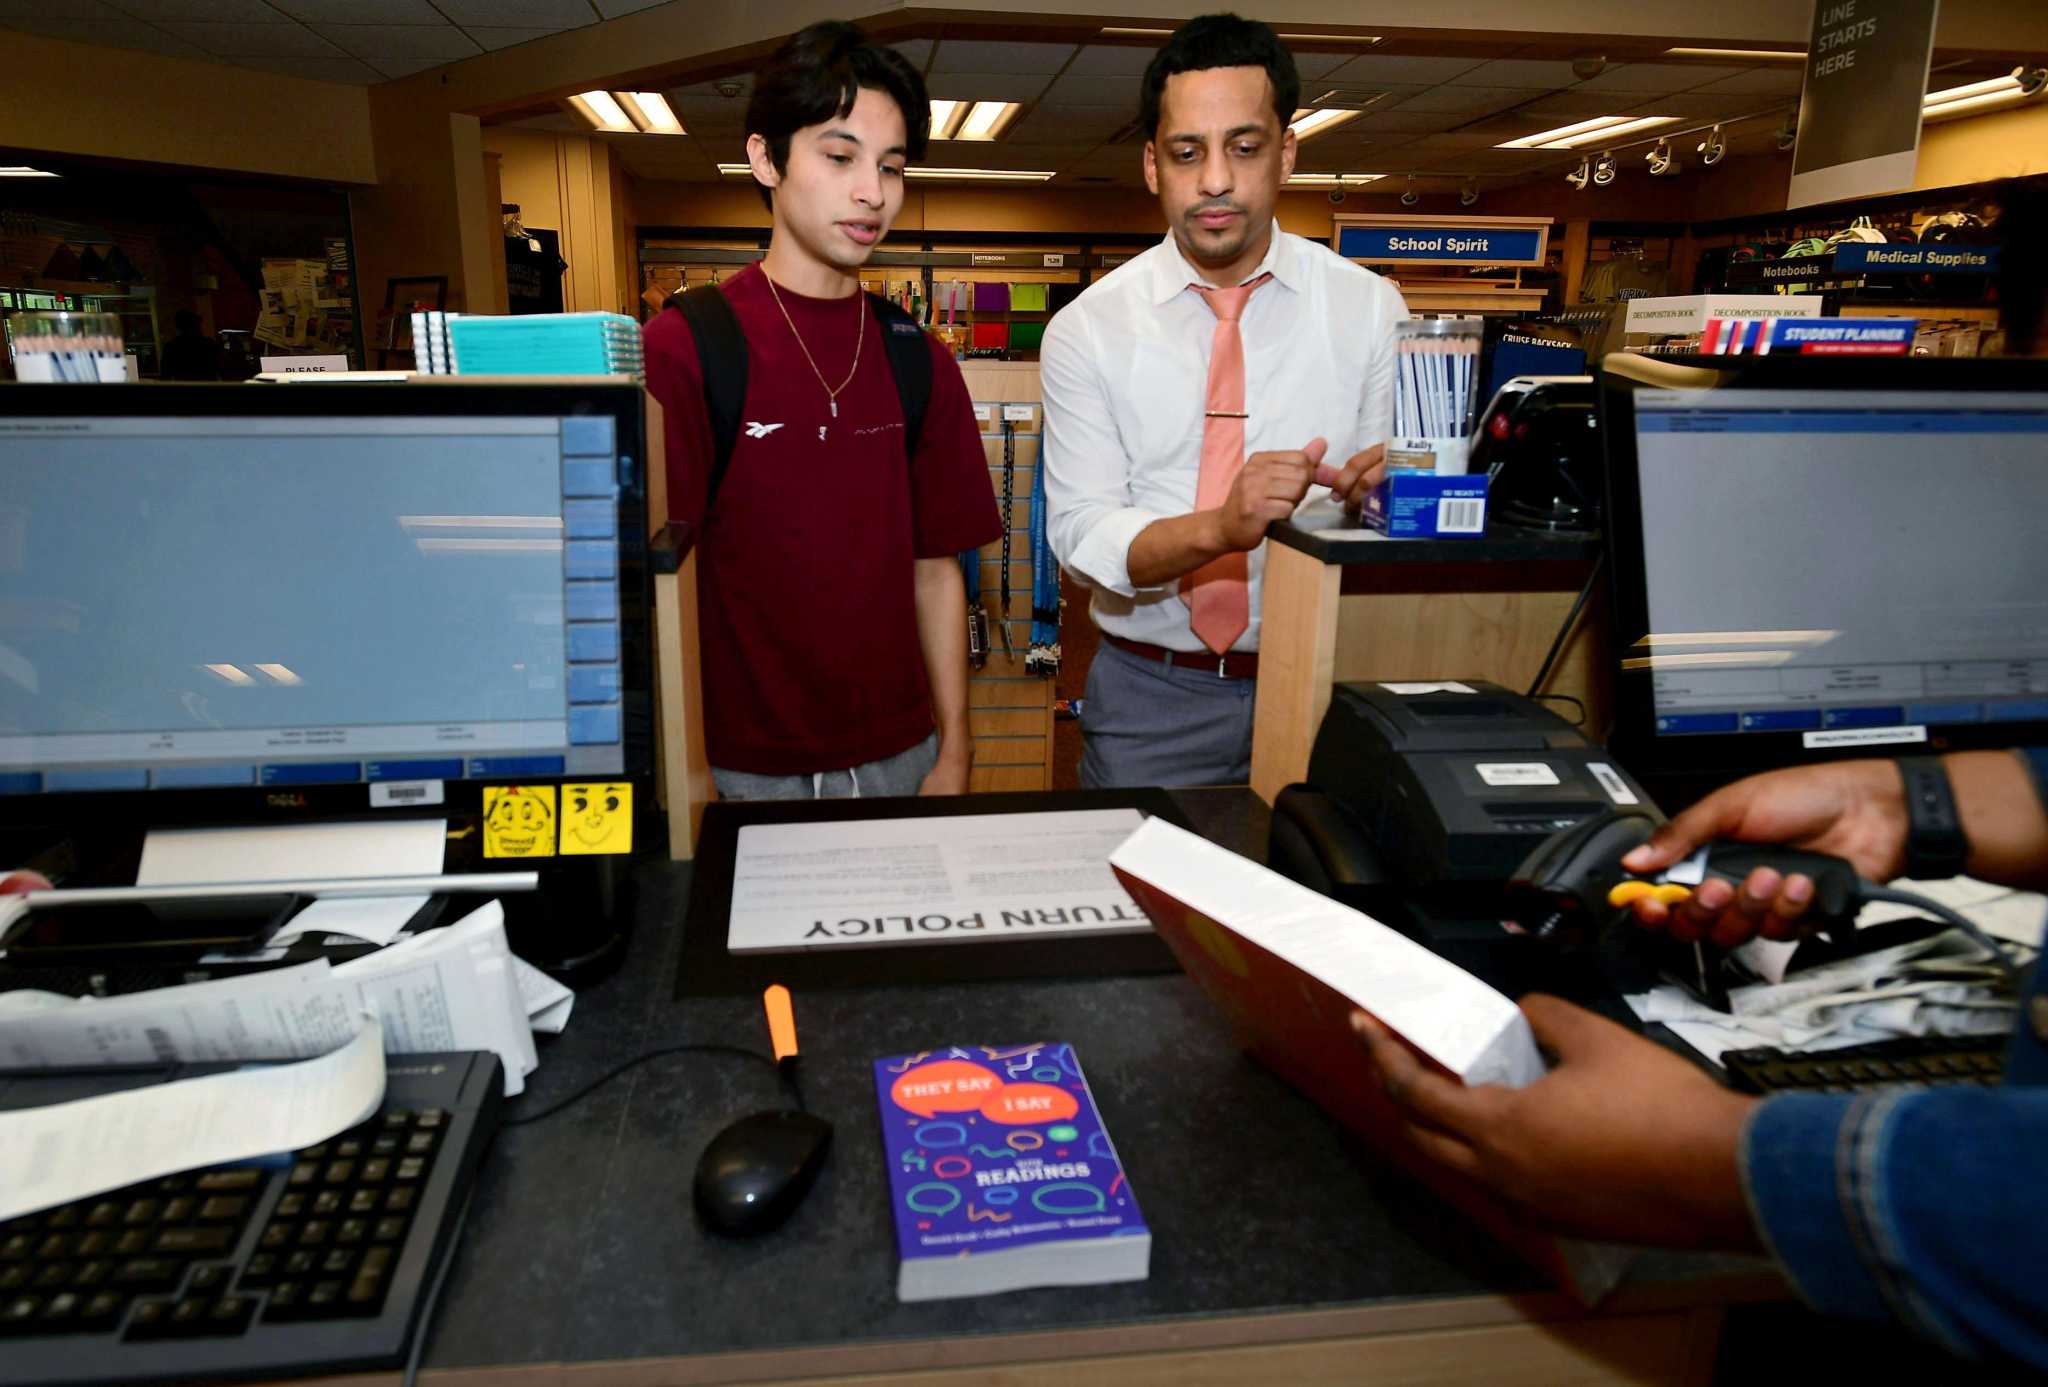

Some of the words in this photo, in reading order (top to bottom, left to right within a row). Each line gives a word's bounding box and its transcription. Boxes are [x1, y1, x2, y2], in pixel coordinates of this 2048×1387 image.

[1822, 0, 1856, 28] LINE
[1817, 16, 1877, 53] STARTS
[1815, 49, 1856, 78] HERE
[1388, 237, 1442, 251] School
[1446, 238, 1489, 253] Spirit
[1866, 249, 1922, 264] Medical
[1926, 251, 1987, 266] Supplies
[1763, 264, 1820, 278] Notebooks
[1632, 310, 1678, 319] DECOMPOSITION
[1713, 308, 1782, 317] DECOMPOSITION
[1783, 328, 1846, 341] STUDENT
[1844, 328, 1906, 341] PLANNER
[1406, 440, 1433, 453] Rally
[803, 912, 985, 938] POLICY
[902, 1081, 951, 1099] THEY
[956, 1077, 993, 1093] SAY
[1003, 1098, 1012, 1112] I
[1016, 1097, 1052, 1111] SAY
[976, 1161, 1090, 1187] READINGS
